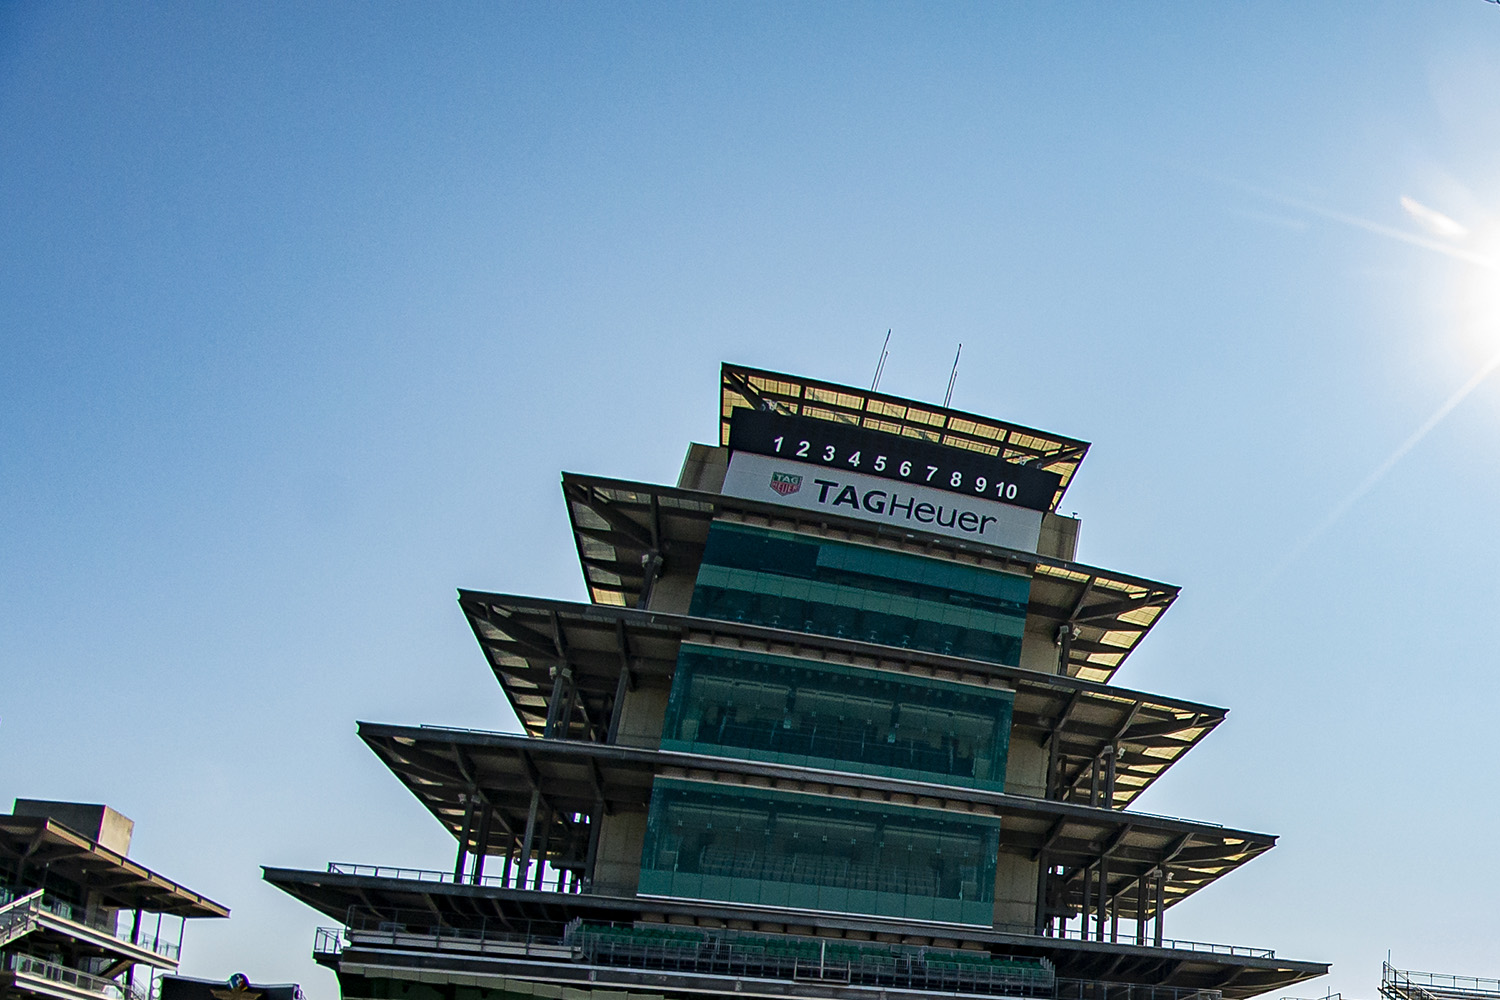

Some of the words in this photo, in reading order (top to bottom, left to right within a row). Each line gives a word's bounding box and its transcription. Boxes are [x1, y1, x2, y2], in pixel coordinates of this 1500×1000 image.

[774, 437, 784, 453] 1
[796, 440, 810, 457] 2
[823, 445, 836, 462] 3
[848, 451, 860, 467] 4
[874, 455, 887, 472] 5
[899, 460, 912, 477] 6
[926, 465, 938, 482] 7
[950, 471, 962, 488] 8
[975, 476, 987, 493] 9
[995, 481, 1018, 500] 10
[776, 474, 799, 485] TAG
